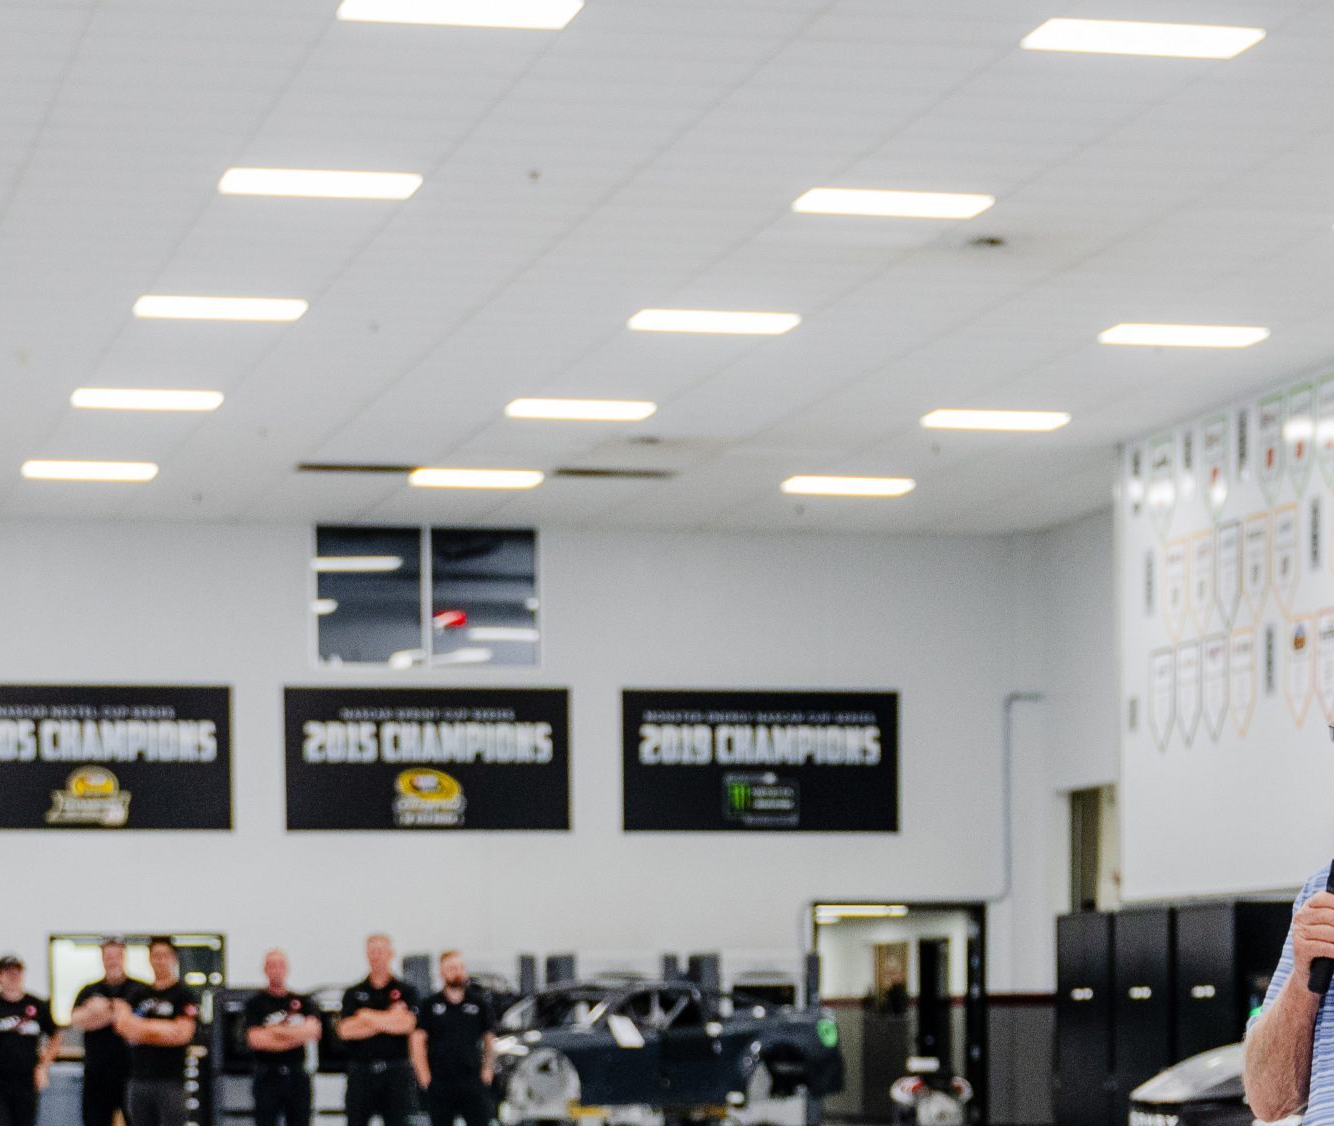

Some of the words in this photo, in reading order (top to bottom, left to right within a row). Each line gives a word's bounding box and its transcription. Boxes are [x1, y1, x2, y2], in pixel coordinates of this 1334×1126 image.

[39, 719, 218, 762] CHAMPIONS
[303, 720, 378, 763] 2015
[380, 721, 554, 764] CHAMPIONS
[639, 724, 712, 765] 2019
[715, 724, 882, 766] CHAMPIONS
